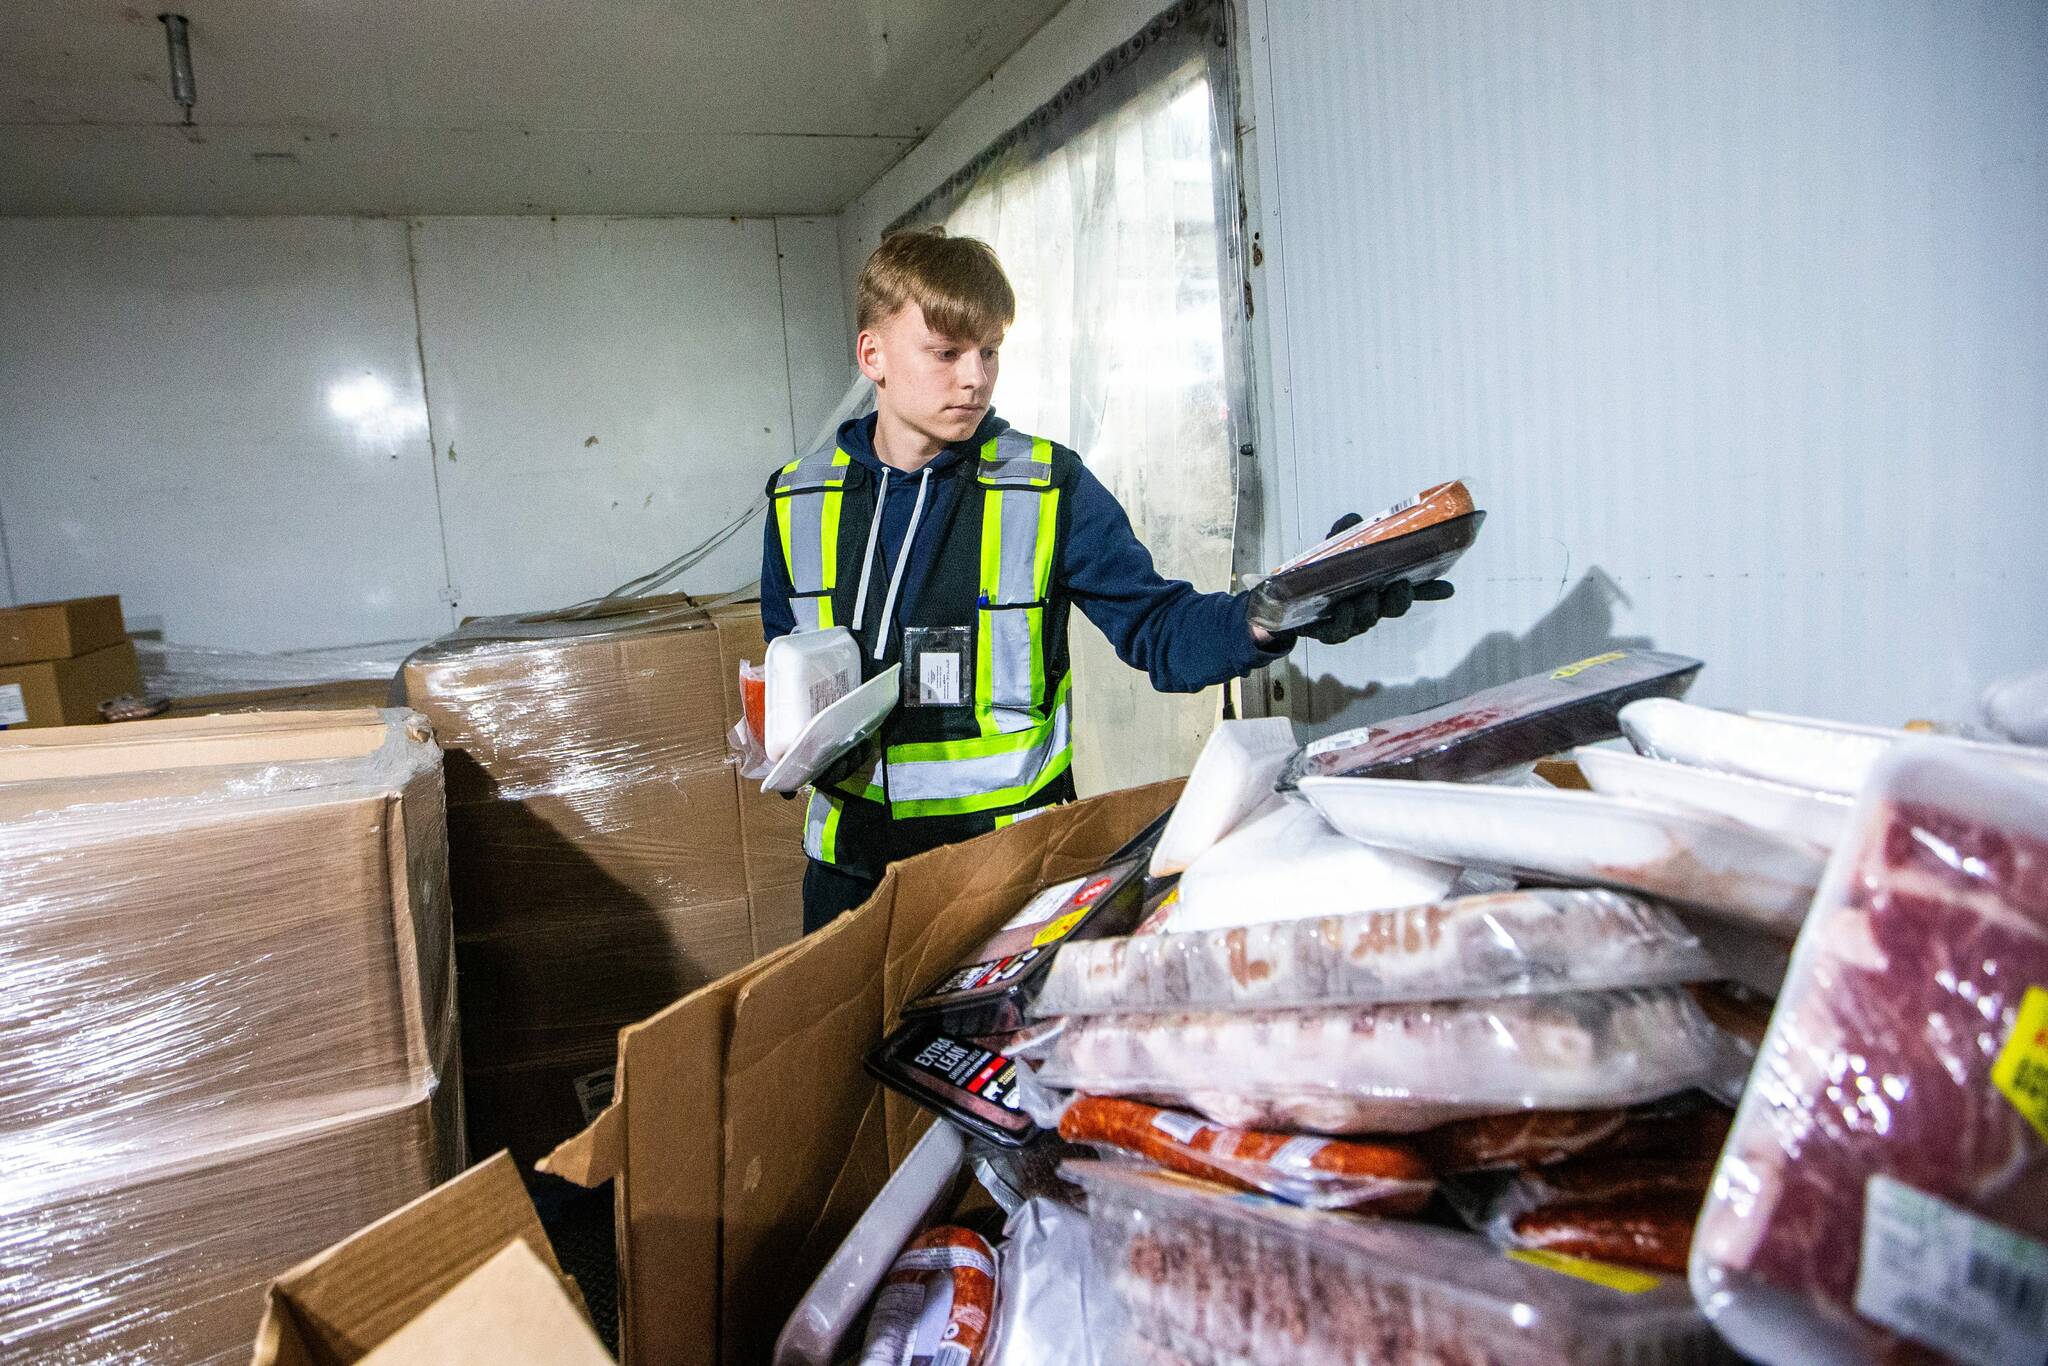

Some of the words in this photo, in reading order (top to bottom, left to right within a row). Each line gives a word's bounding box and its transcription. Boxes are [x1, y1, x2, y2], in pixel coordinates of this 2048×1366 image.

[914, 1037, 955, 1067] EXTRA
[933, 1045, 969, 1072] LEAN
[948, 1059, 971, 1080] GROUND
